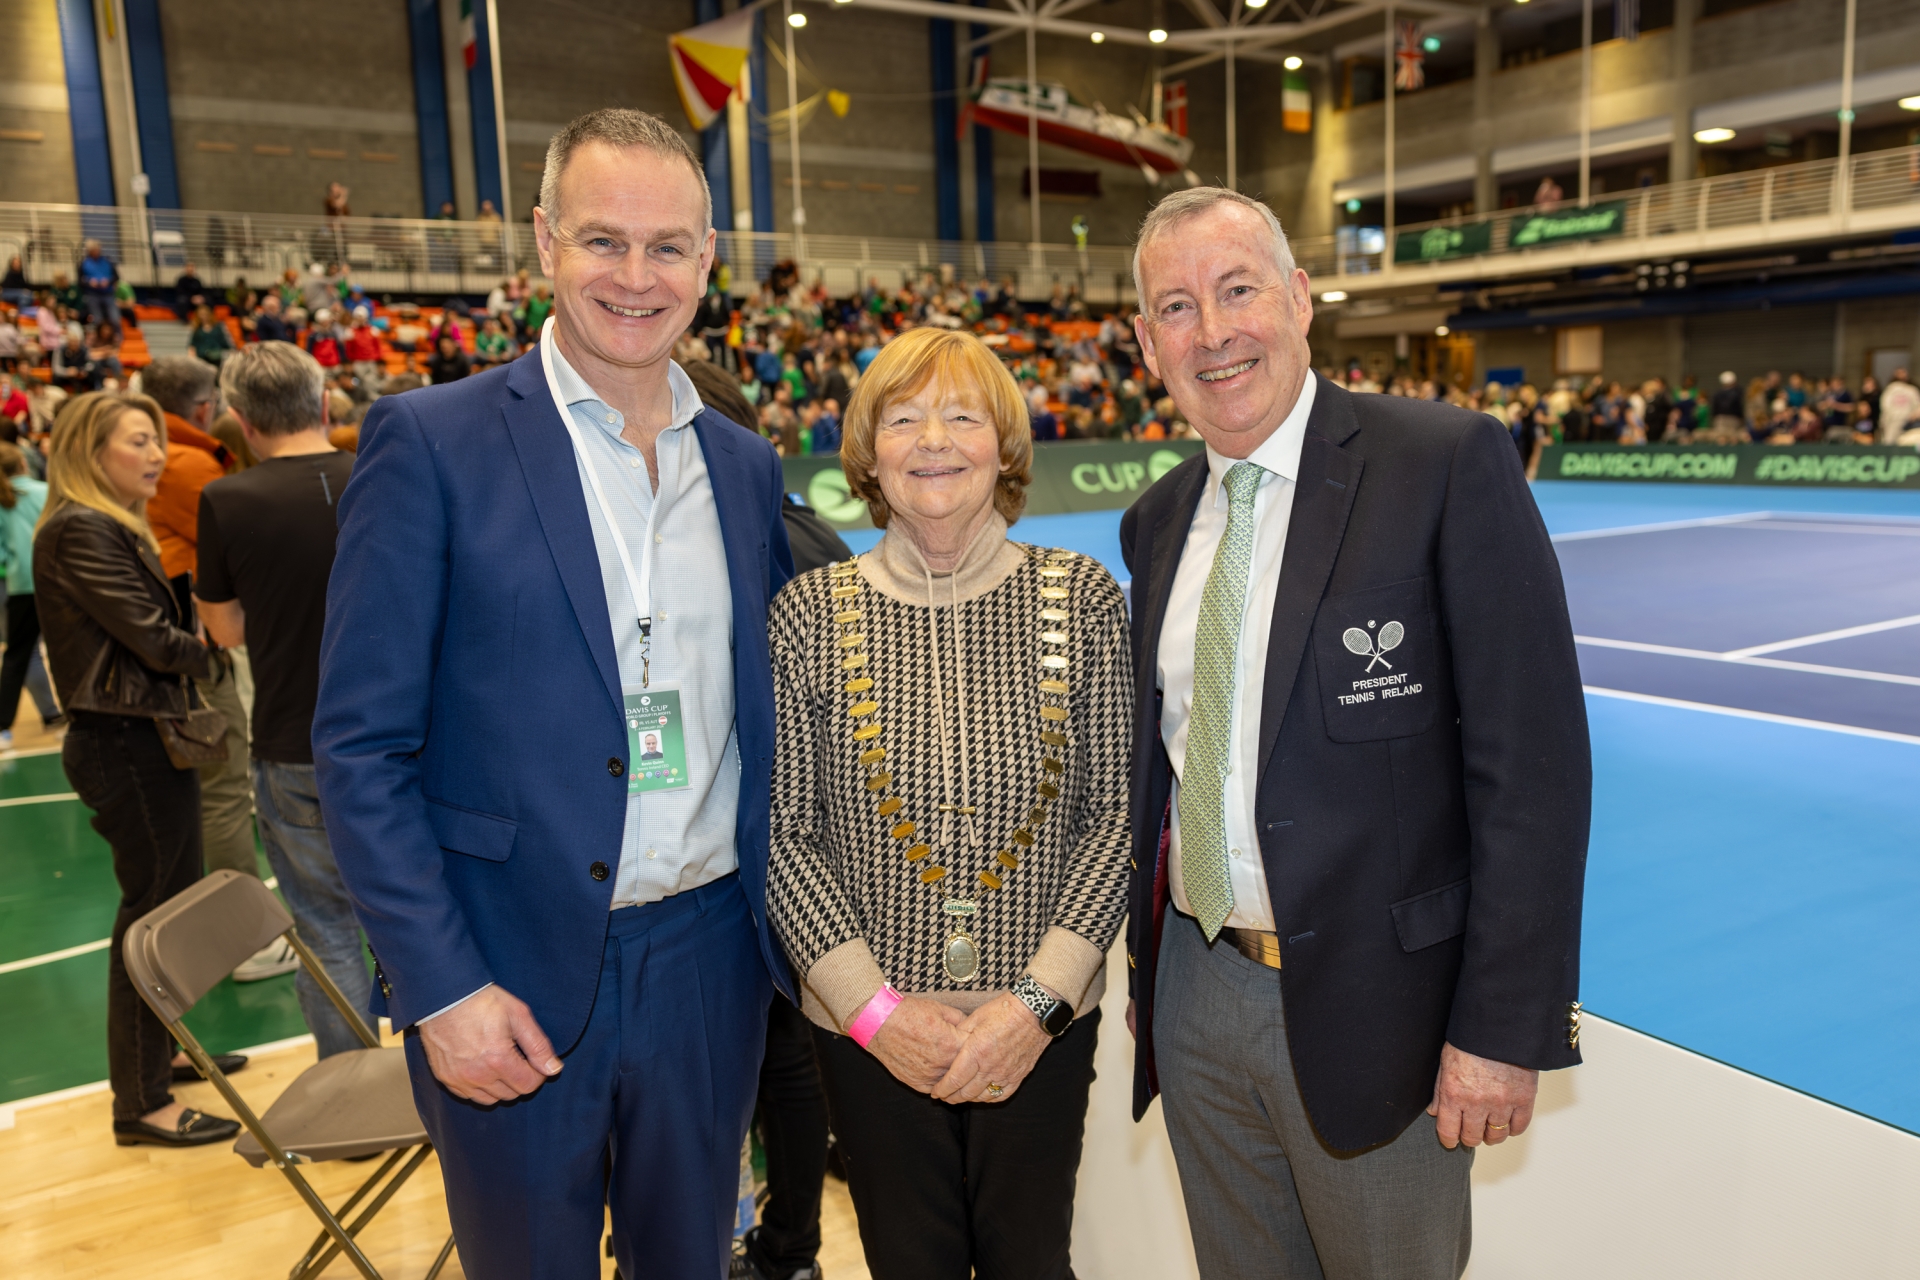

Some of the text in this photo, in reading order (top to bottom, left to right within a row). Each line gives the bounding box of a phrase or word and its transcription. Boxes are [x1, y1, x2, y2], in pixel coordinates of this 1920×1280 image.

[1070, 461, 1145, 494] CUP
[1560, 452, 1738, 479] DAVISCUP.COM
[1755, 454, 1920, 482] #DAVISCUP
[1338, 683, 1423, 706] TENNIS IRELAND
[1352, 673, 1408, 691] PRESIDENT
[625, 704, 668, 715] DAVIS CUP
